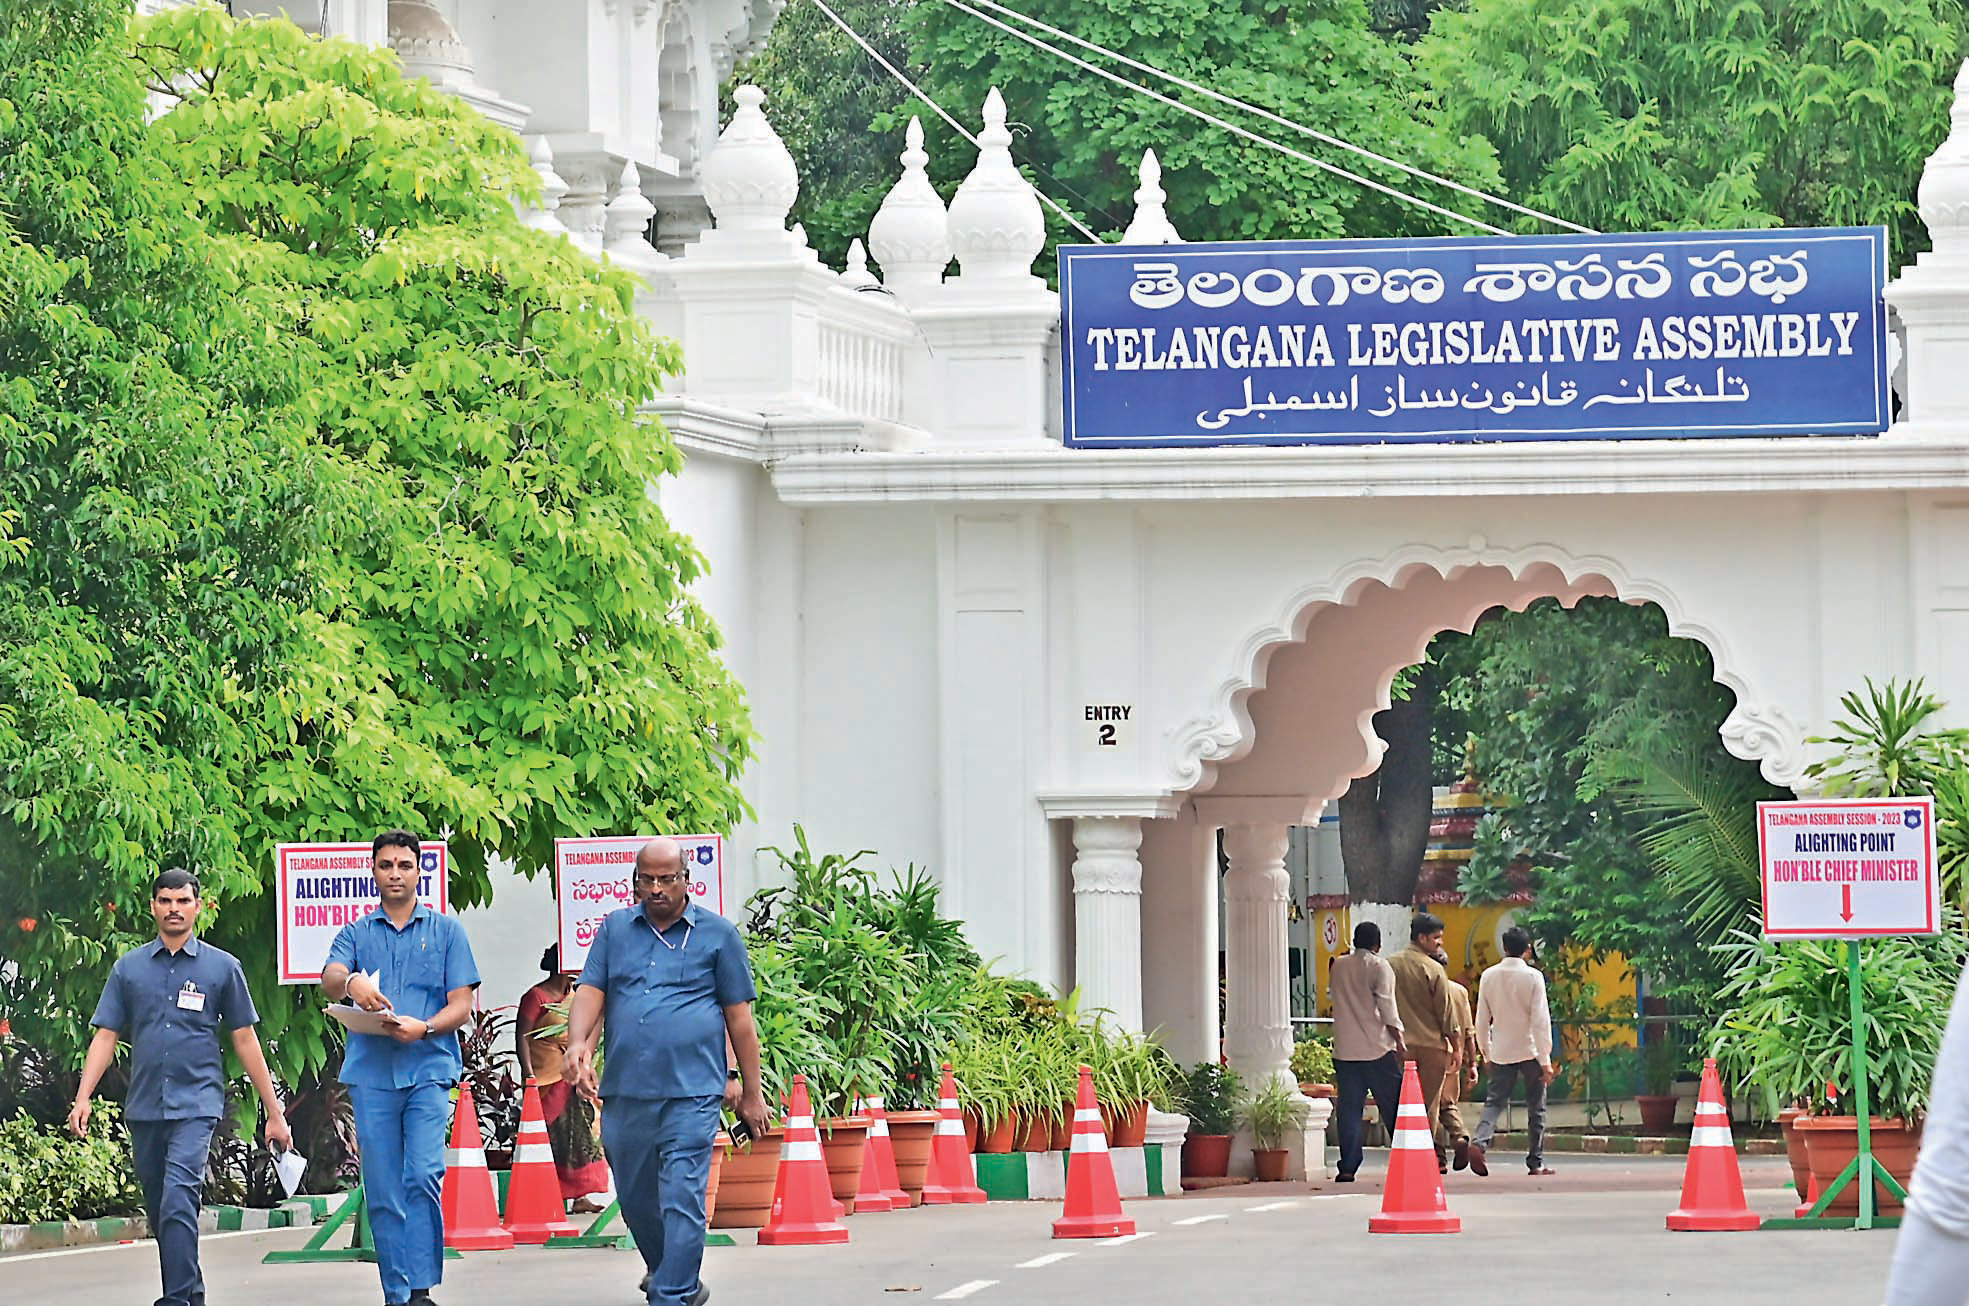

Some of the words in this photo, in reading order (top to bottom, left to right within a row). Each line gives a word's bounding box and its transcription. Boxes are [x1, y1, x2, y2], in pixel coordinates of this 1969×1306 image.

[1129, 262, 1445, 309] తెలంగాణ
[1462, 253, 1672, 302] శాసన
[1687, 250, 1808, 304] సభ
[1087, 324, 1336, 371] TELANGANA
[1347, 318, 1621, 366] LEGISLATIVE
[1632, 311, 1859, 361] ASSEMBLY
[1196, 374, 1360, 430] اسمبلی
[1085, 705, 1131, 720] ENTRY
[1098, 724, 1117, 745] 2
[1768, 814, 1808, 826] TELANGANA
[1809, 813, 1845, 825] ASSEMBLY
[1846, 813, 1877, 825] SESSION
[1882, 812, 1901, 824] 2023
[1795, 833, 1857, 852] ALIGHTING
[1860, 833, 1896, 852] POINT
[289, 858, 329, 870] TELANGANA
[330, 857, 364, 869] ASSEMBLY
[565, 853, 604, 865] TELANGANA
[1773, 860, 1822, 882] HON'BLE
[1824, 860, 1859, 881] CHIEF
[1861, 859, 1919, 881] MINISTER
